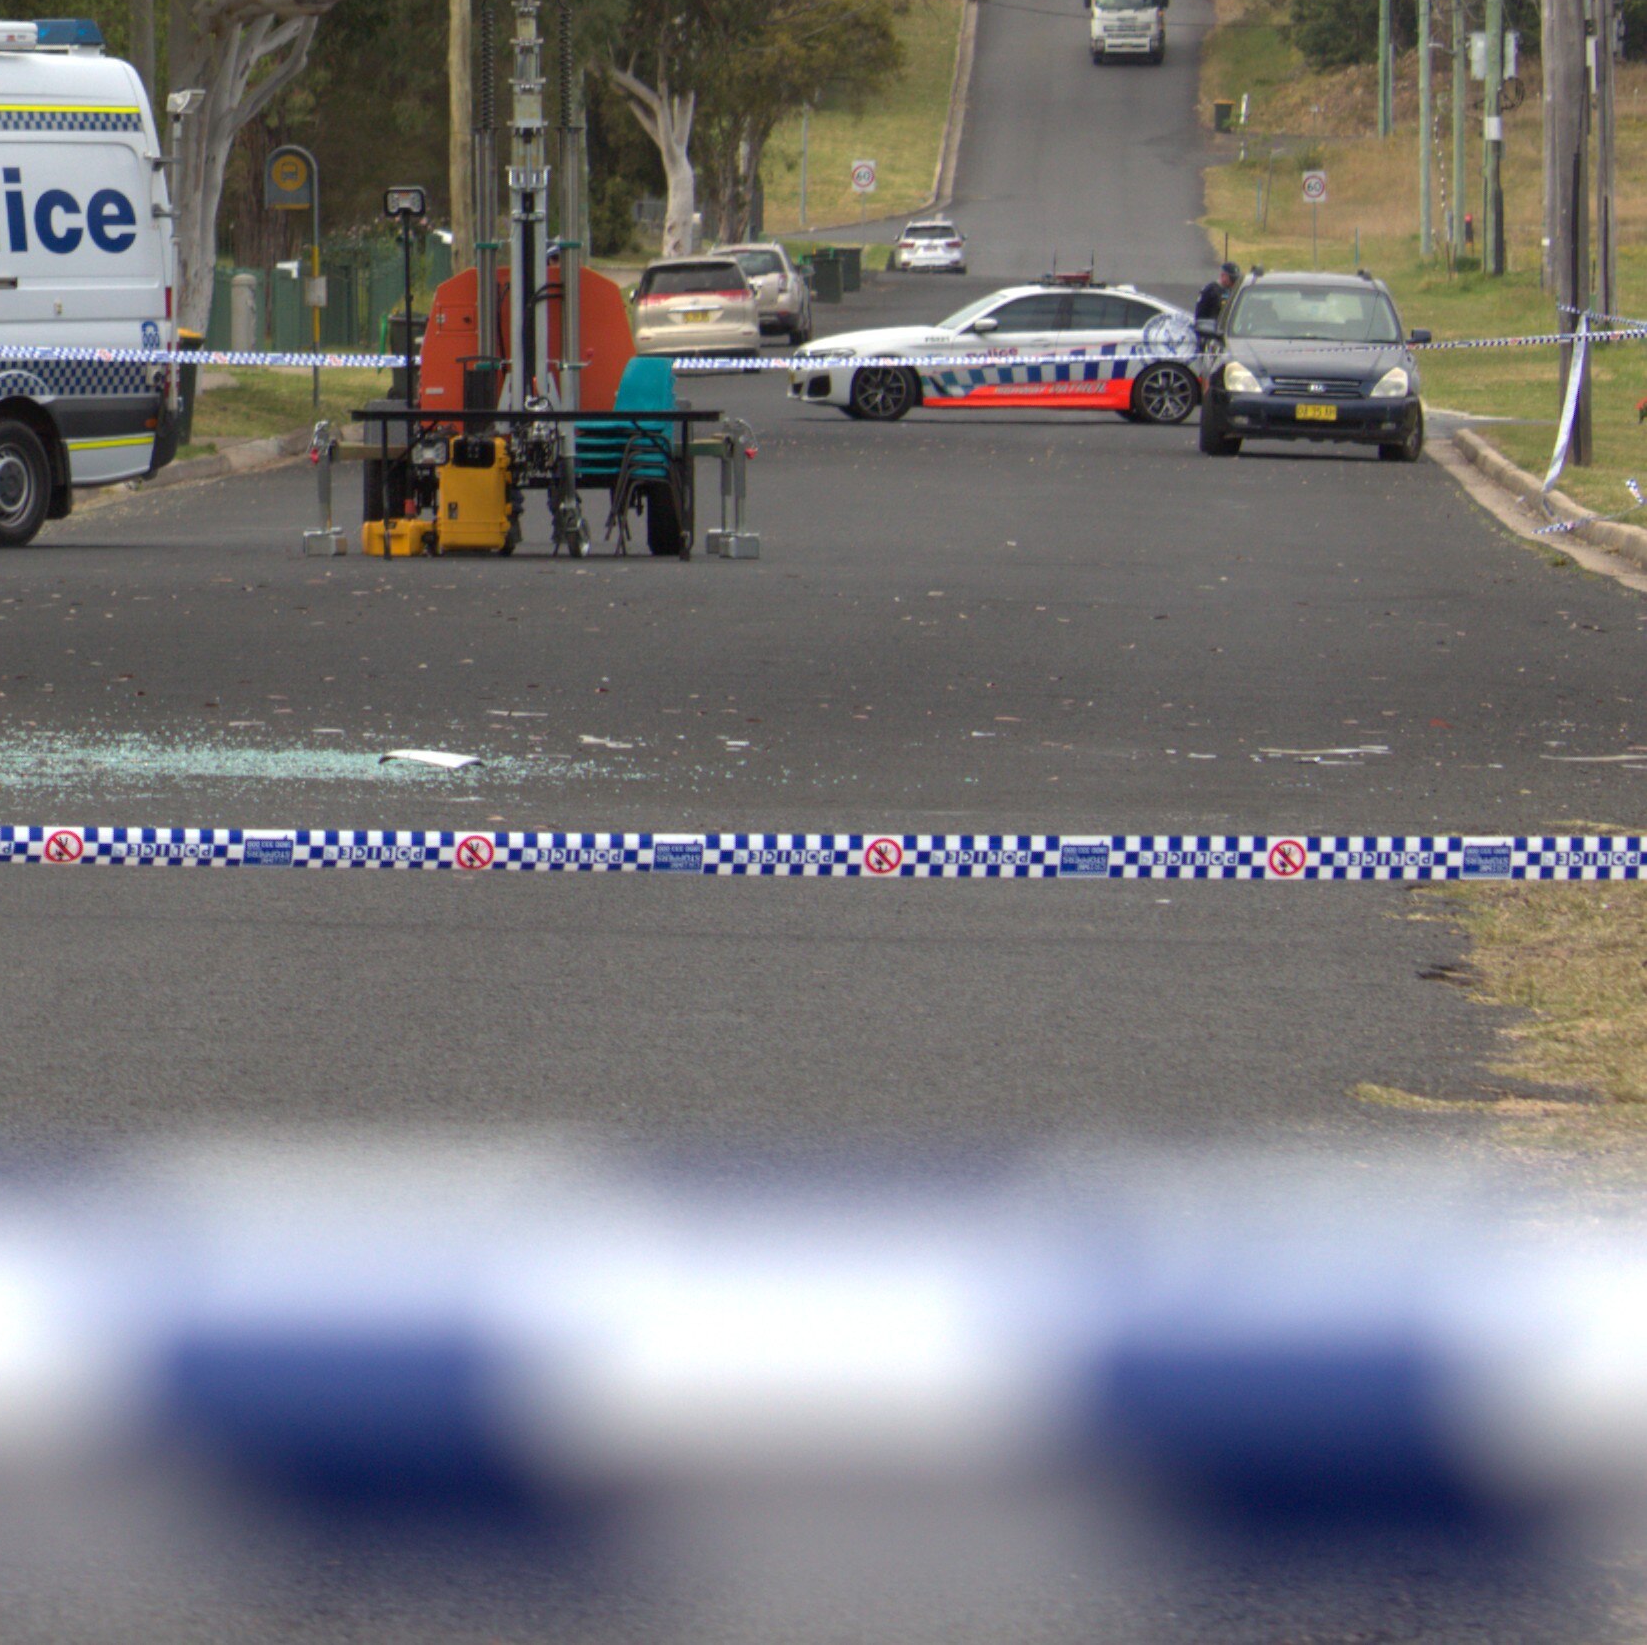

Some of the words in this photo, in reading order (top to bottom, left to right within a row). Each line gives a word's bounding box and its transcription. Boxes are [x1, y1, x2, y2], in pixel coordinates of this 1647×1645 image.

[130, 844, 213, 857] POLICE
[339, 847, 424, 860] POLICE
[538, 848, 623, 862] POLICE
[751, 849, 832, 862] POLICE
[946, 851, 1029, 864] POLICE
[1156, 852, 1237, 865] POLICE
[1350, 852, 1432, 865] POLICE
[1556, 852, 1639, 865] POLICE
